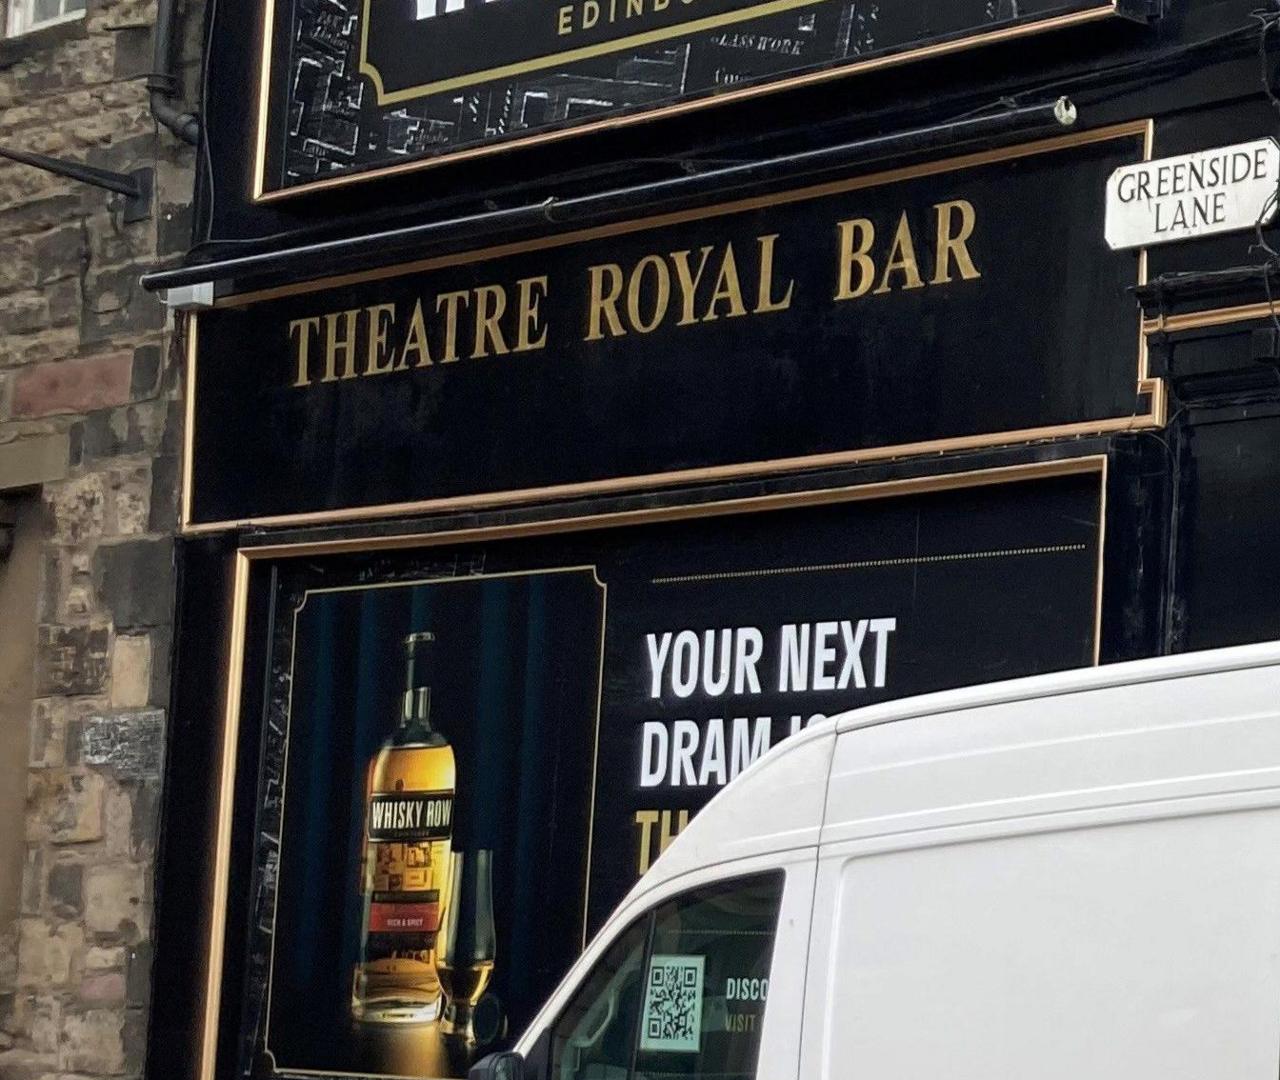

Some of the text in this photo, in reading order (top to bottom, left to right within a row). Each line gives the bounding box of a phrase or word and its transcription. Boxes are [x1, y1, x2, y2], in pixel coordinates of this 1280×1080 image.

[557, 0, 693, 35] EDIN
[1116, 149, 1269, 204] GREENSIDE
[1154, 193, 1226, 234] LANE
[289, 199, 982, 388] THEATRE ROYAL BAR
[646, 617, 897, 698] YOUR NEXT
[640, 716, 771, 787] DRAM
[372, 799, 451, 829] WHISKY ROW
[726, 977, 770, 1001] DISCO
[725, 1013, 756, 1033] VISIT
